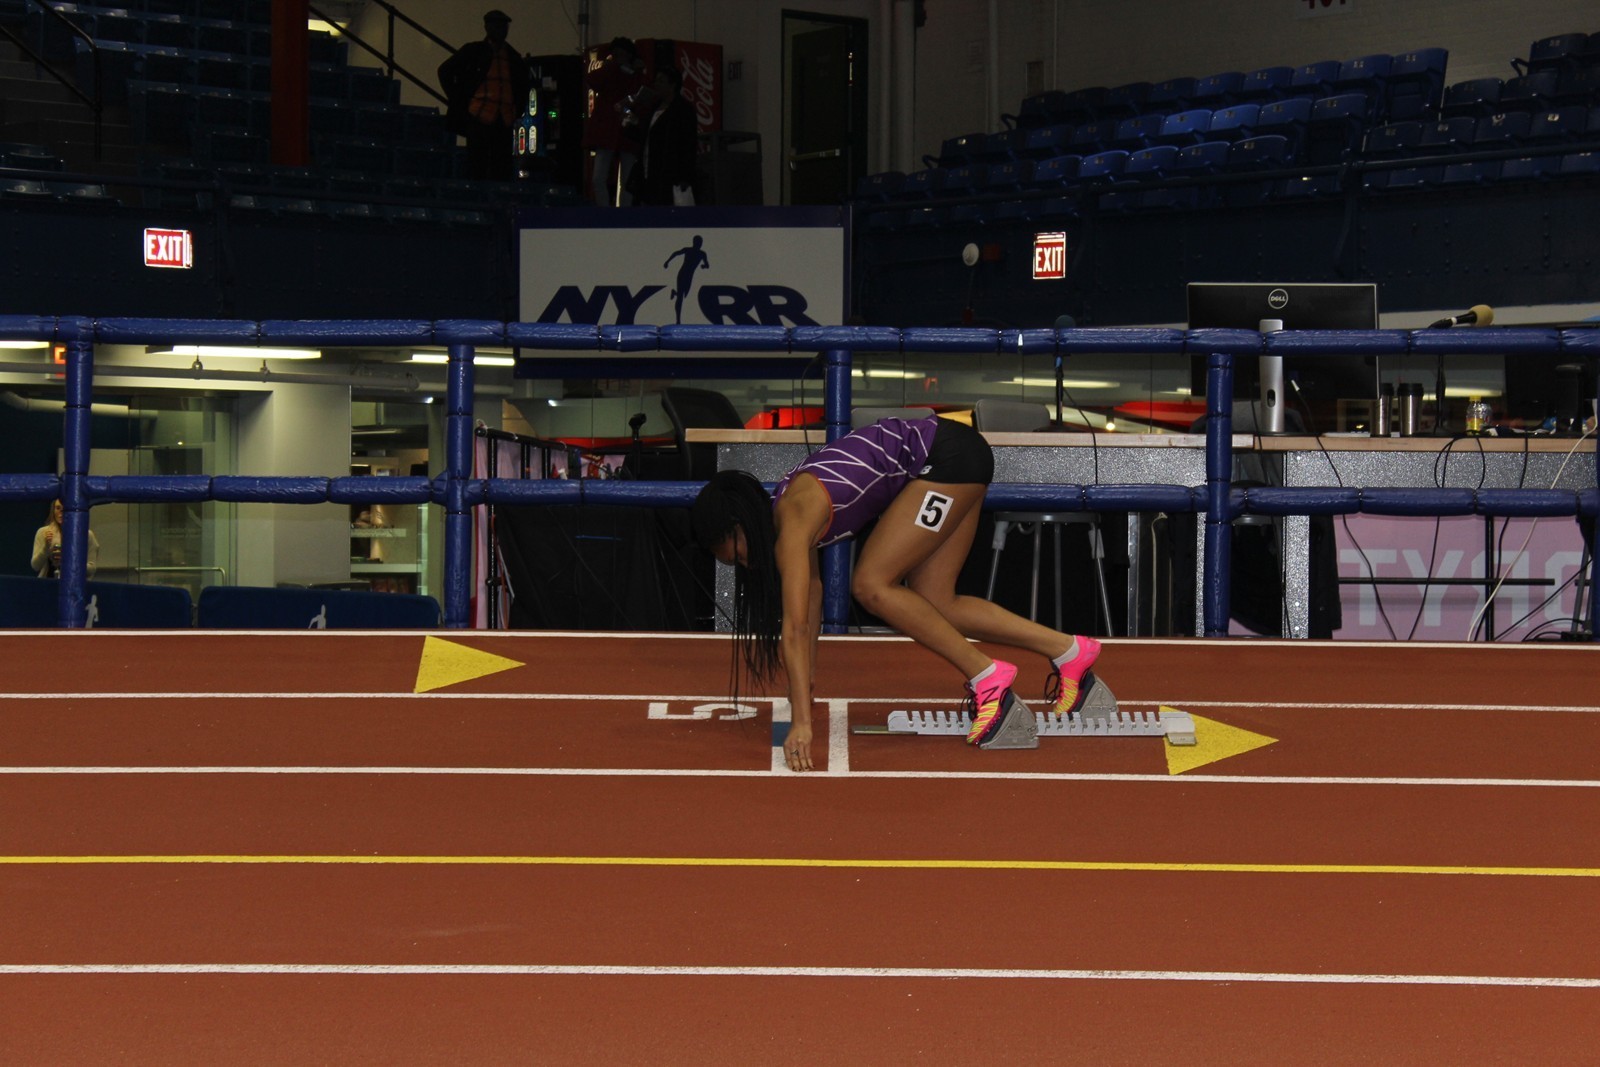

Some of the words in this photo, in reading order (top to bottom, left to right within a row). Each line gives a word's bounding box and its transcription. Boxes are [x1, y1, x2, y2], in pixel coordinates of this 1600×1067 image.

[681, 48, 714, 126] Cola
[147, 234, 183, 262] EXIT
[1035, 246, 1063, 272] EXIT
[921, 495, 947, 528] 5
